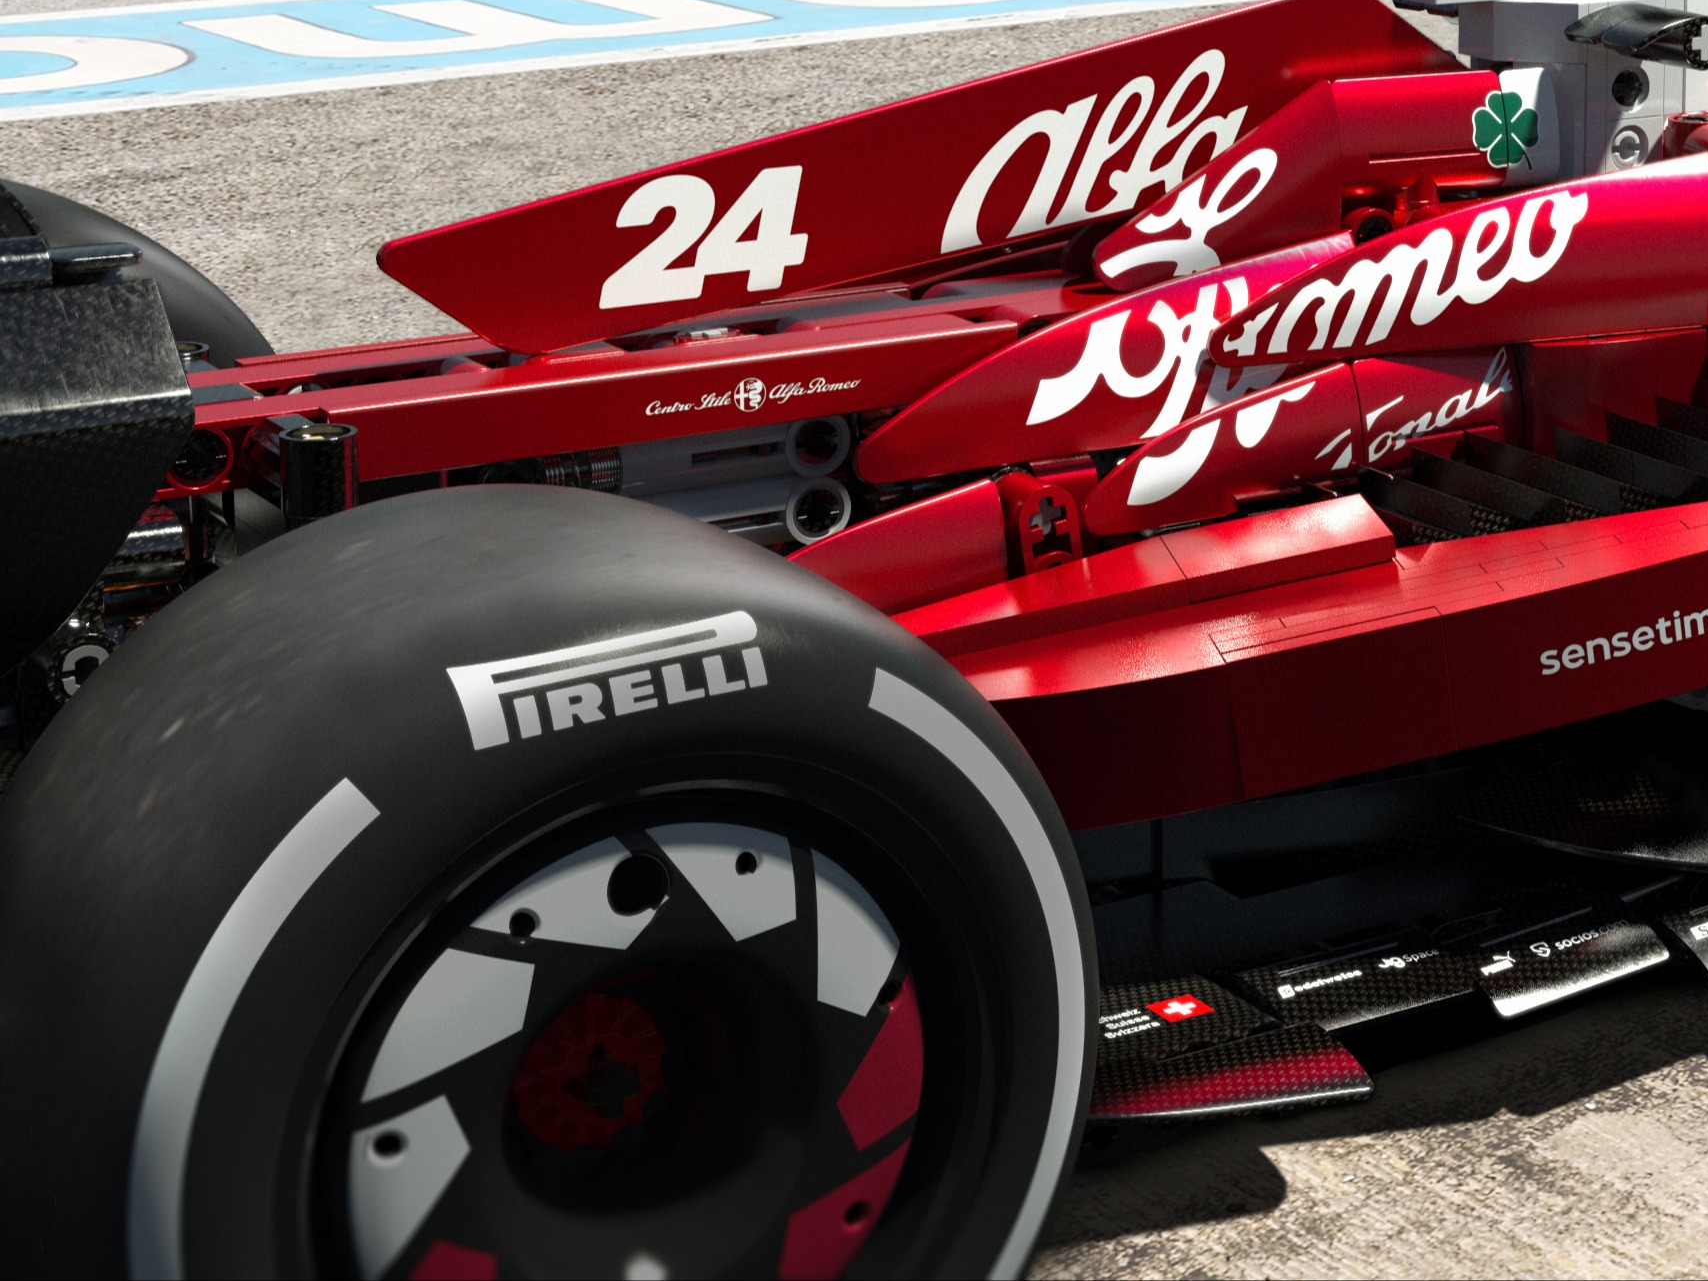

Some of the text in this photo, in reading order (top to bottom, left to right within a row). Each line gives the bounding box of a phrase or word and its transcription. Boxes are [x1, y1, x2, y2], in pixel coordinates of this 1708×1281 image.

[940, 48, 1250, 256] Alfa
[599, 165, 808, 310] 24
[645, 377, 862, 416] Centro Stile Alfa Romeo
[447, 610, 768, 751] PIRELLI
[1294, 969, 1363, 993] edelweiss
[1104, 1020, 1161, 1040] Svizzera
[1105, 1014, 1151, 1030] Suisse
